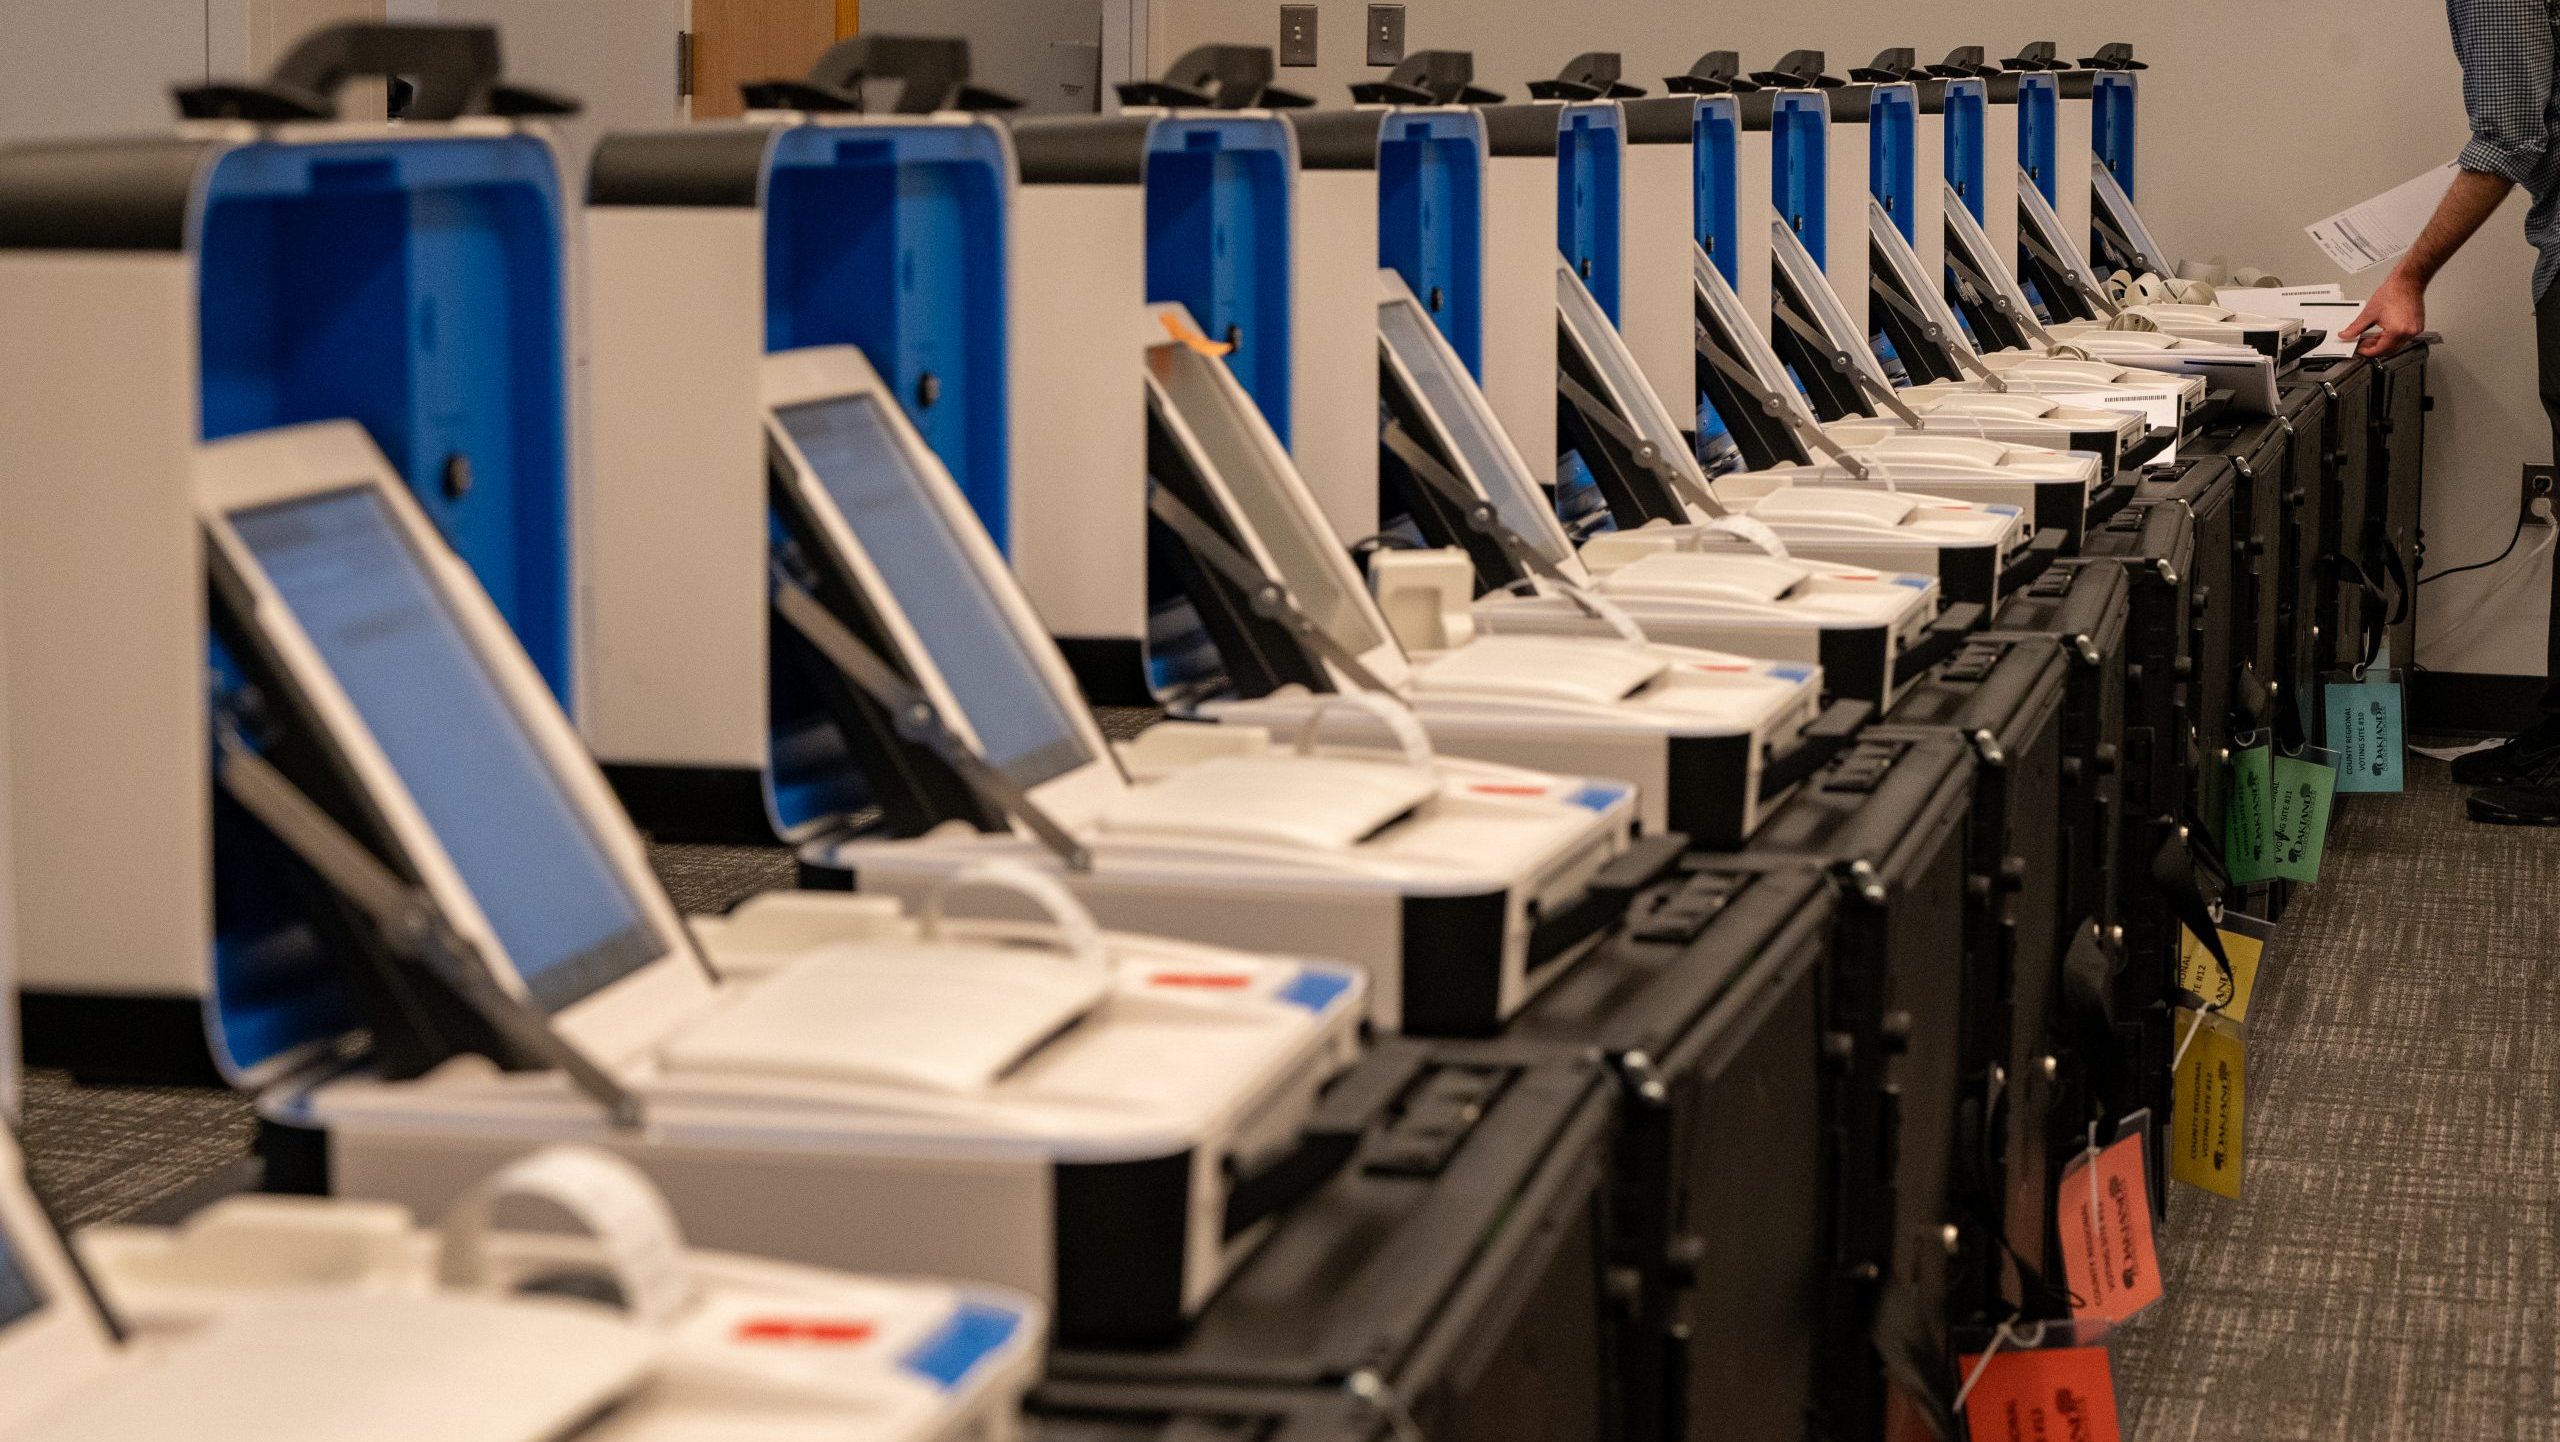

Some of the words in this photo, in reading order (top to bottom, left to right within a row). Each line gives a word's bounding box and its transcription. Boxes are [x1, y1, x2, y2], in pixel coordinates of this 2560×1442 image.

[2344, 707, 2352, 744] REGIONAL
[2358, 743, 2366, 771] VOTING
[2284, 791, 2293, 805] #11
[2280, 806, 2290, 821] SITE
[2275, 822, 2287, 853] VONG
[2195, 964, 2207, 982] #12
